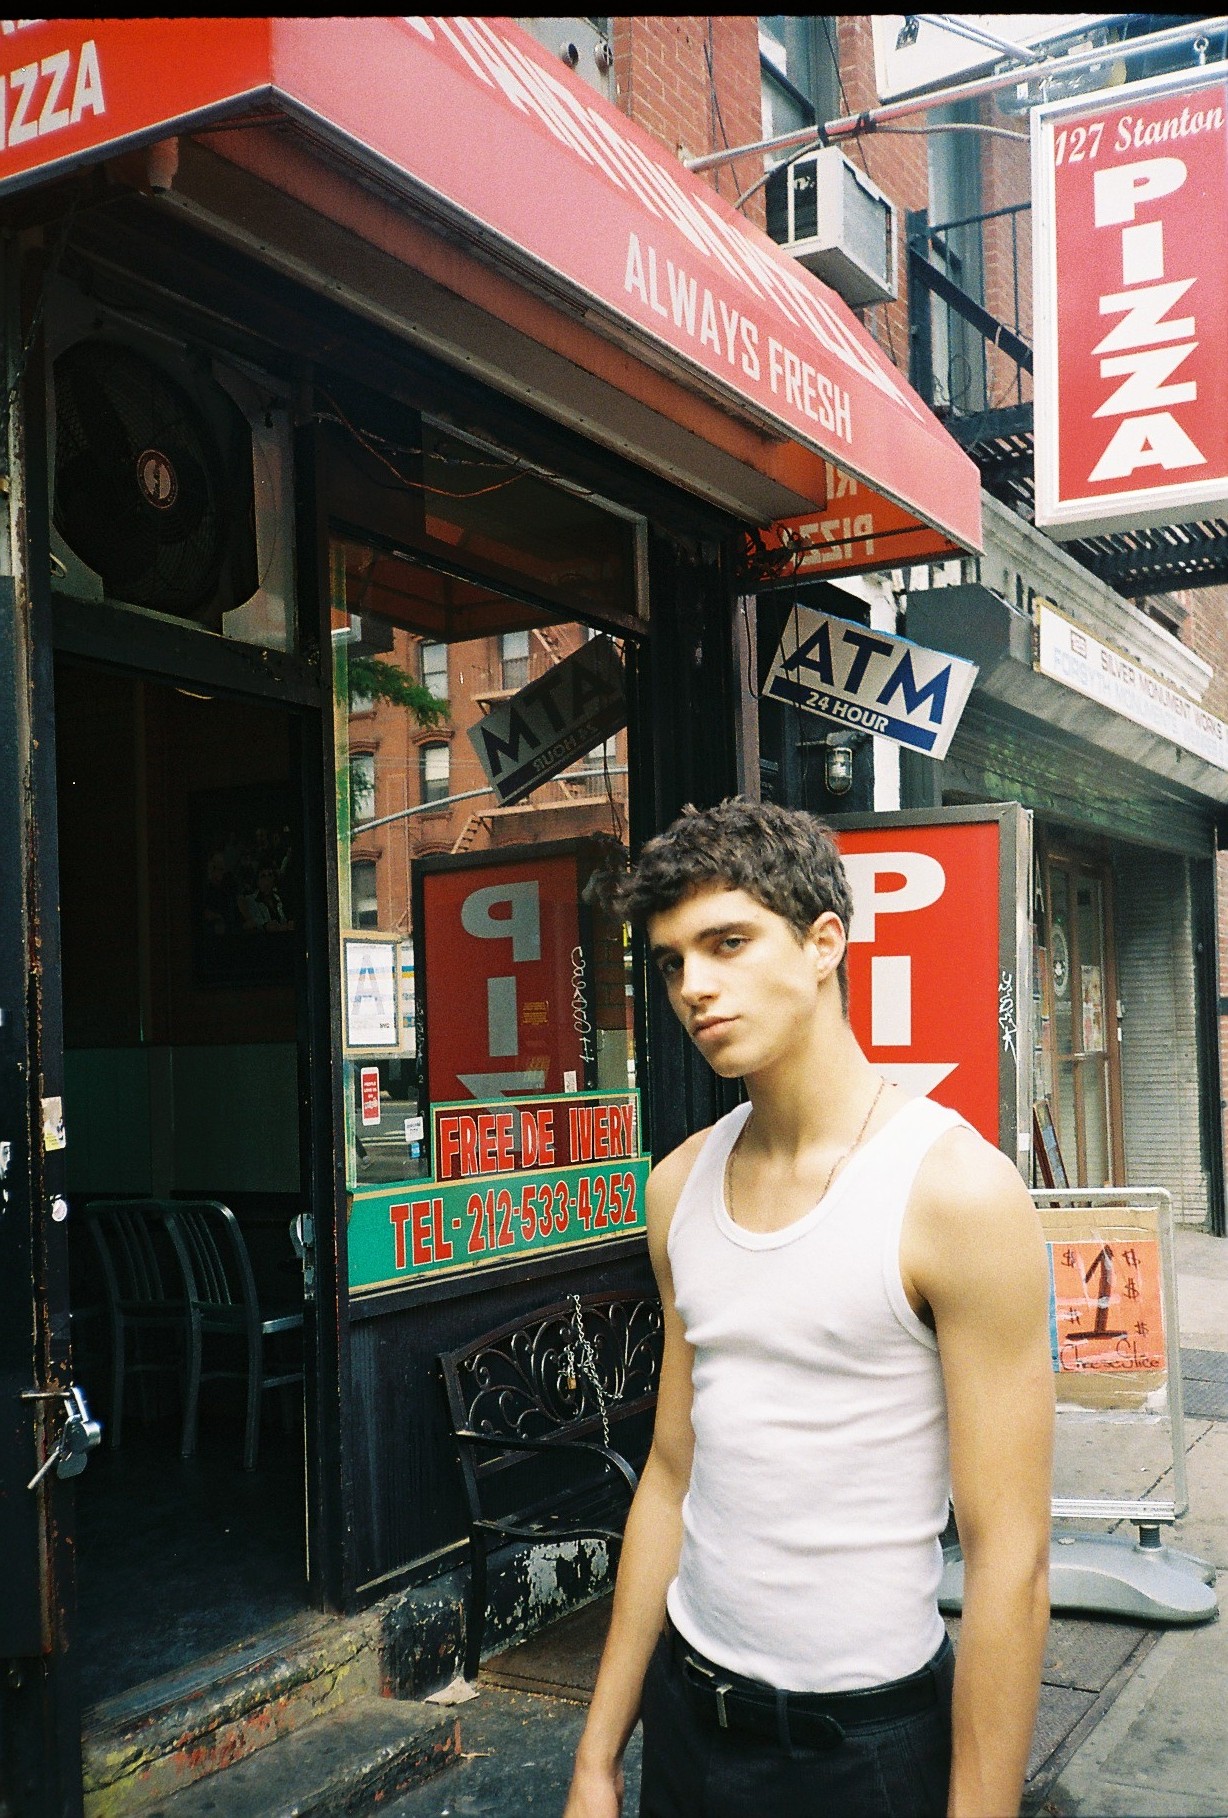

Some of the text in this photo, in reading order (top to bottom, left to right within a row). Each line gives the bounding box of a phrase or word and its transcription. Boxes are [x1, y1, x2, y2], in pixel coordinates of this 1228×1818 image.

[1055, 106, 1226, 167] 127 Stanton
[624, 231, 853, 445] ALWAYS FRESH
[689, 192, 926, 424] PIZZA
[1087, 156, 1208, 483] PIZZA
[780, 619, 952, 725] ATM
[805, 690, 890, 733] 24 HOUR
[1100, 648, 1136, 685] SILVER
[1138, 672, 1191, 719] MONUMENT
[1194, 710, 1224, 741] WORKS
[351, 953, 386, 1016] A
[439, 1103, 635, 1179] FREE DEIVERY
